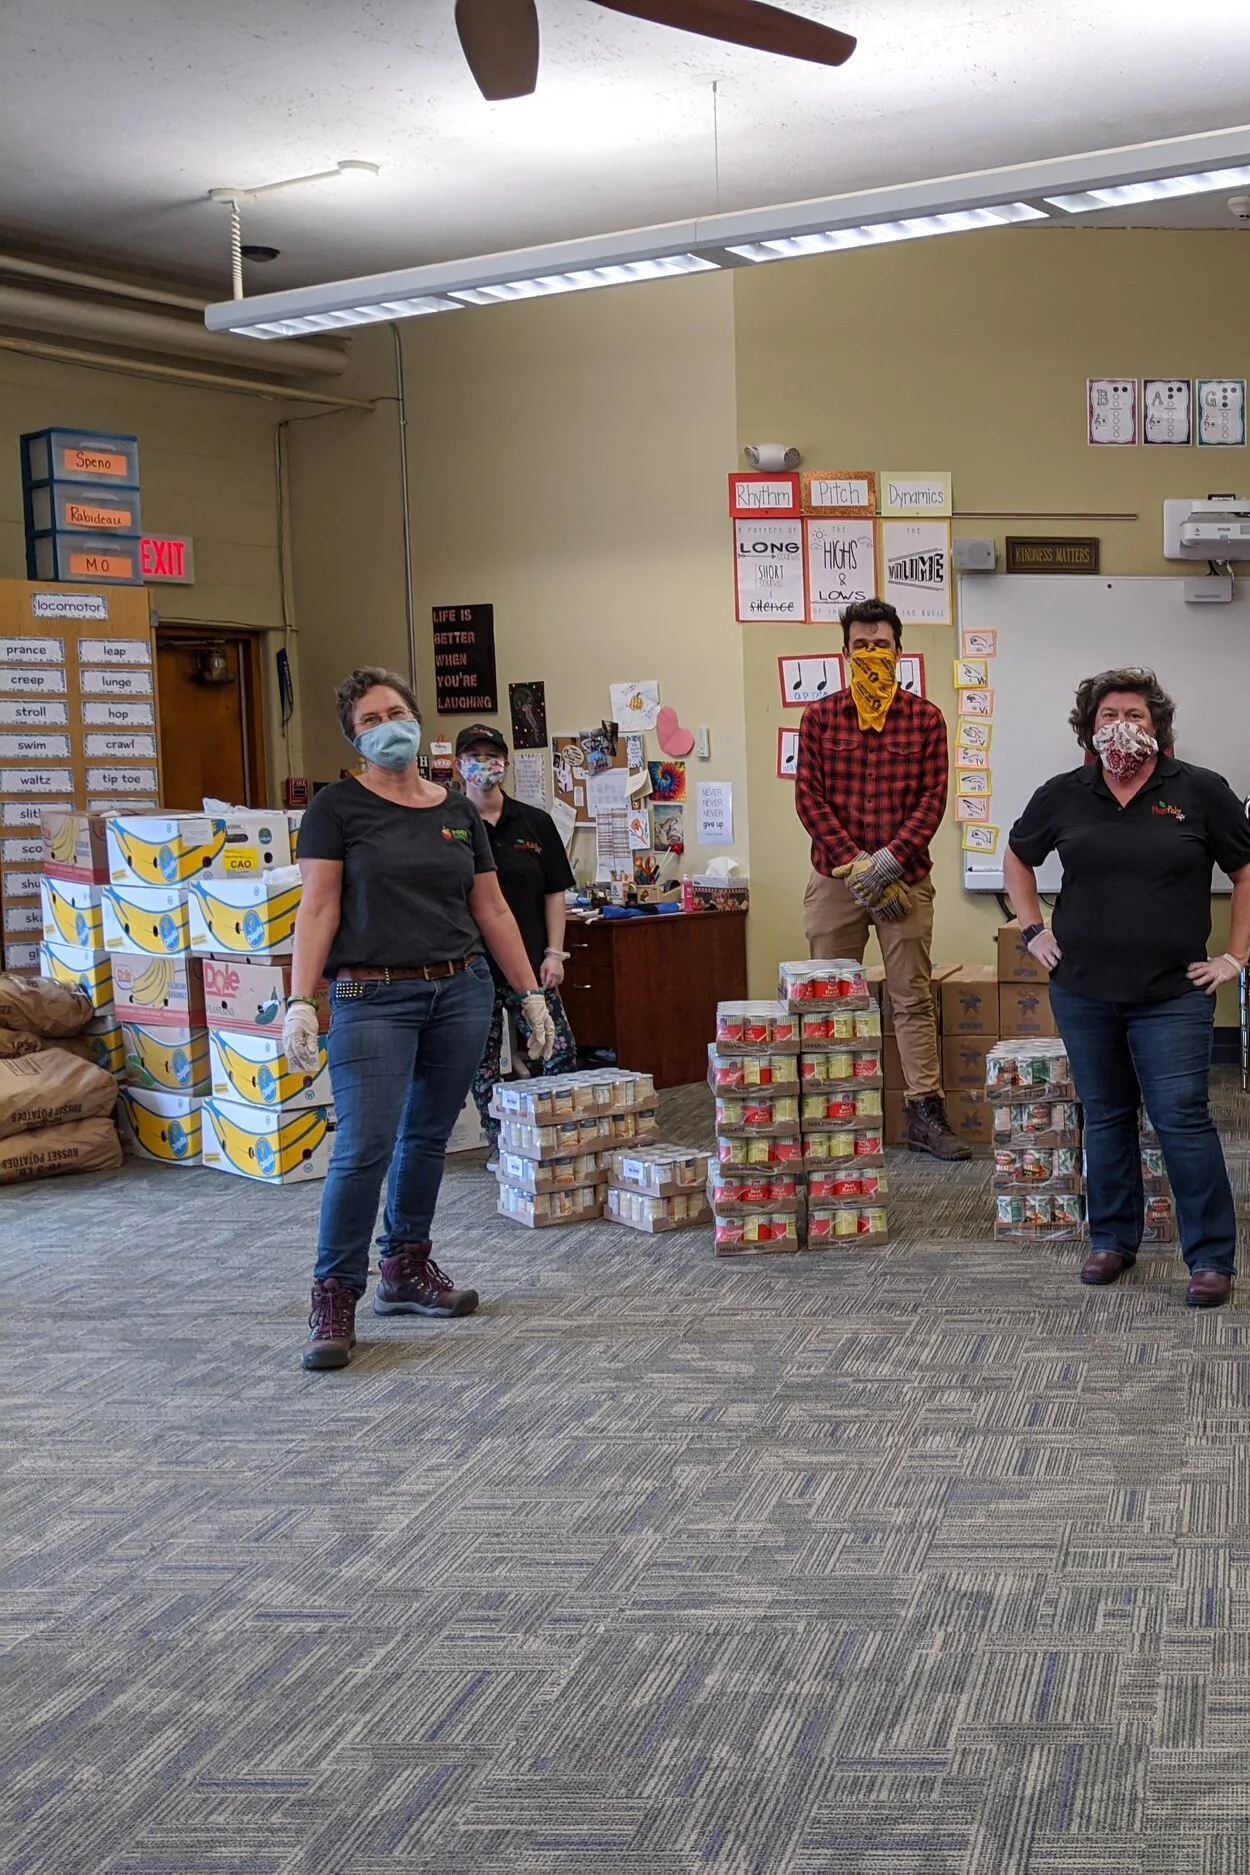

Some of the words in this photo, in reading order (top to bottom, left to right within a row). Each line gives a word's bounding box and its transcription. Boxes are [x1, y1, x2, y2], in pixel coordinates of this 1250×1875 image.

[1096, 389, 1109, 406] B
[1151, 390, 1164, 406] A
[1205, 390, 1217, 407] G
[76, 453, 111, 470] Speno
[737, 485, 790, 508] Rhythm
[819, 482, 860, 504] Pitch
[889, 484, 943, 508] Dynamics
[70, 507, 122, 525] Rabideau
[740, 542, 800, 553] LONG
[1015, 547, 1053, 562] KINDNESS
[1055, 547, 1090, 562] MATTERS
[140, 539, 185, 577] EXIT
[823, 540, 858, 570] HIGHS
[758, 564, 784, 580] SHORT
[888, 553, 944, 583] VOLUME
[838, 572, 847, 586] &
[819, 590, 866, 601] LOWS
[37, 600, 102, 613] locomotor
[749, 600, 795, 612] silence
[433, 609, 456, 622] LIFE
[460, 608, 472, 621] IS
[434, 631, 475, 645] BETTER
[6, 645, 47, 656] prance
[104, 646, 126, 658] leap
[435, 653, 467, 667] WHEN
[11, 675, 45, 687] creep
[102, 677, 132, 689] lunge
[437, 672, 478, 688] YOU'RE
[438, 696, 492, 709] LAUGHING
[15, 707, 46, 717] stroll
[108, 708, 129, 721] hop
[18, 741, 47, 750] swim
[106, 739, 135, 749] crawl
[20, 774, 51, 785] waltz
[102, 773, 118, 786] tip
[122, 774, 141, 784] toe
[20, 808, 41, 819] slit
[22, 845, 42, 854] sco
[230, 859, 252, 869] CAO
[22, 879, 41, 889] shu
[26, 914, 42, 924] ska
[117, 969, 132, 981] Dole
[204, 962, 241, 992] Dole
[11, 1107, 51, 1123] POTATOES
[1, 1153, 45, 1169] POTATOES
[48, 1147, 79, 1162] RUSSET
